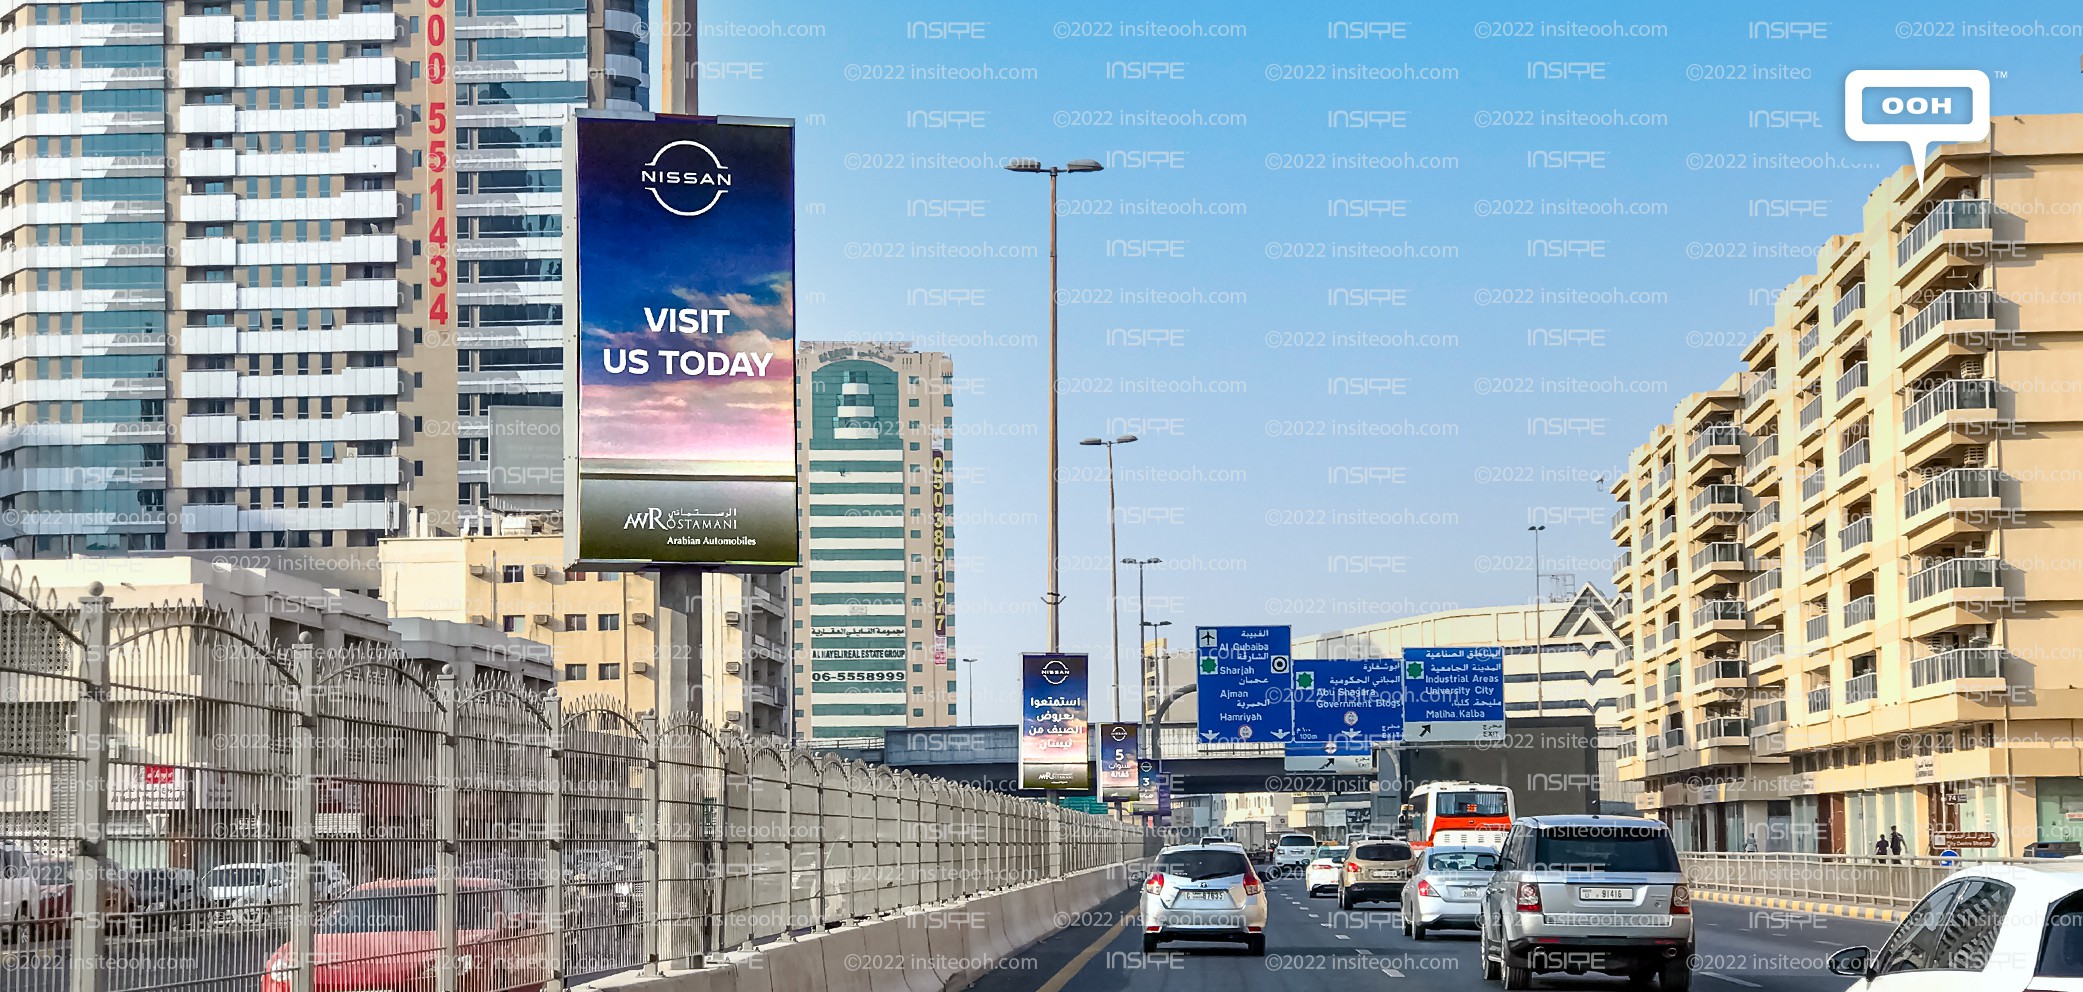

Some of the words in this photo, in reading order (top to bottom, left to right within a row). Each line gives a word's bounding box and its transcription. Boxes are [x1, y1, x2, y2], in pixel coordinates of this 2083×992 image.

[427, 0, 446, 85] 00
[641, 170, 732, 187] NISSAN
[644, 307, 731, 334] VISIT
[603, 349, 650, 375] US
[658, 350, 774, 377] TODAY
[667, 536, 701, 546] Arabian
[702, 536, 757, 546] Automobiles
[1220, 643, 1229, 651] Al
[1233, 643, 1269, 651] Gubaiba
[843, 650, 860, 658] REAL
[861, 650, 884, 658] ESTATE
[884, 650, 906, 659] GROUP
[1219, 666, 1255, 675] Sharjah
[812, 672, 905, 682] 06-5558999
[1238, 676, 1269, 685] عجمان
[1425, 675, 1469, 683] Industrial
[1472, 675, 1499, 683] Areas
[1220, 689, 1249, 699] Ajman
[1316, 688, 1335, 697] Abu
[1425, 686, 1471, 696] University
[1474, 686, 1494, 696] City
[1030, 696, 1081, 709] استمتعوا
[1316, 700, 1372, 708] Government
[1375, 699, 1401, 709] Bldgs
[1036, 710, 1075, 723] بعروض
[1220, 713, 1263, 722] Hamriyah
[1459, 709, 1485, 718] Kalba
[1028, 725, 1044, 736] من
[1047, 724, 1083, 737] الصيف
[1039, 738, 1073, 750] نيسان
[1115, 748, 1125, 761] 5
[1142, 777, 1150, 786] 3
